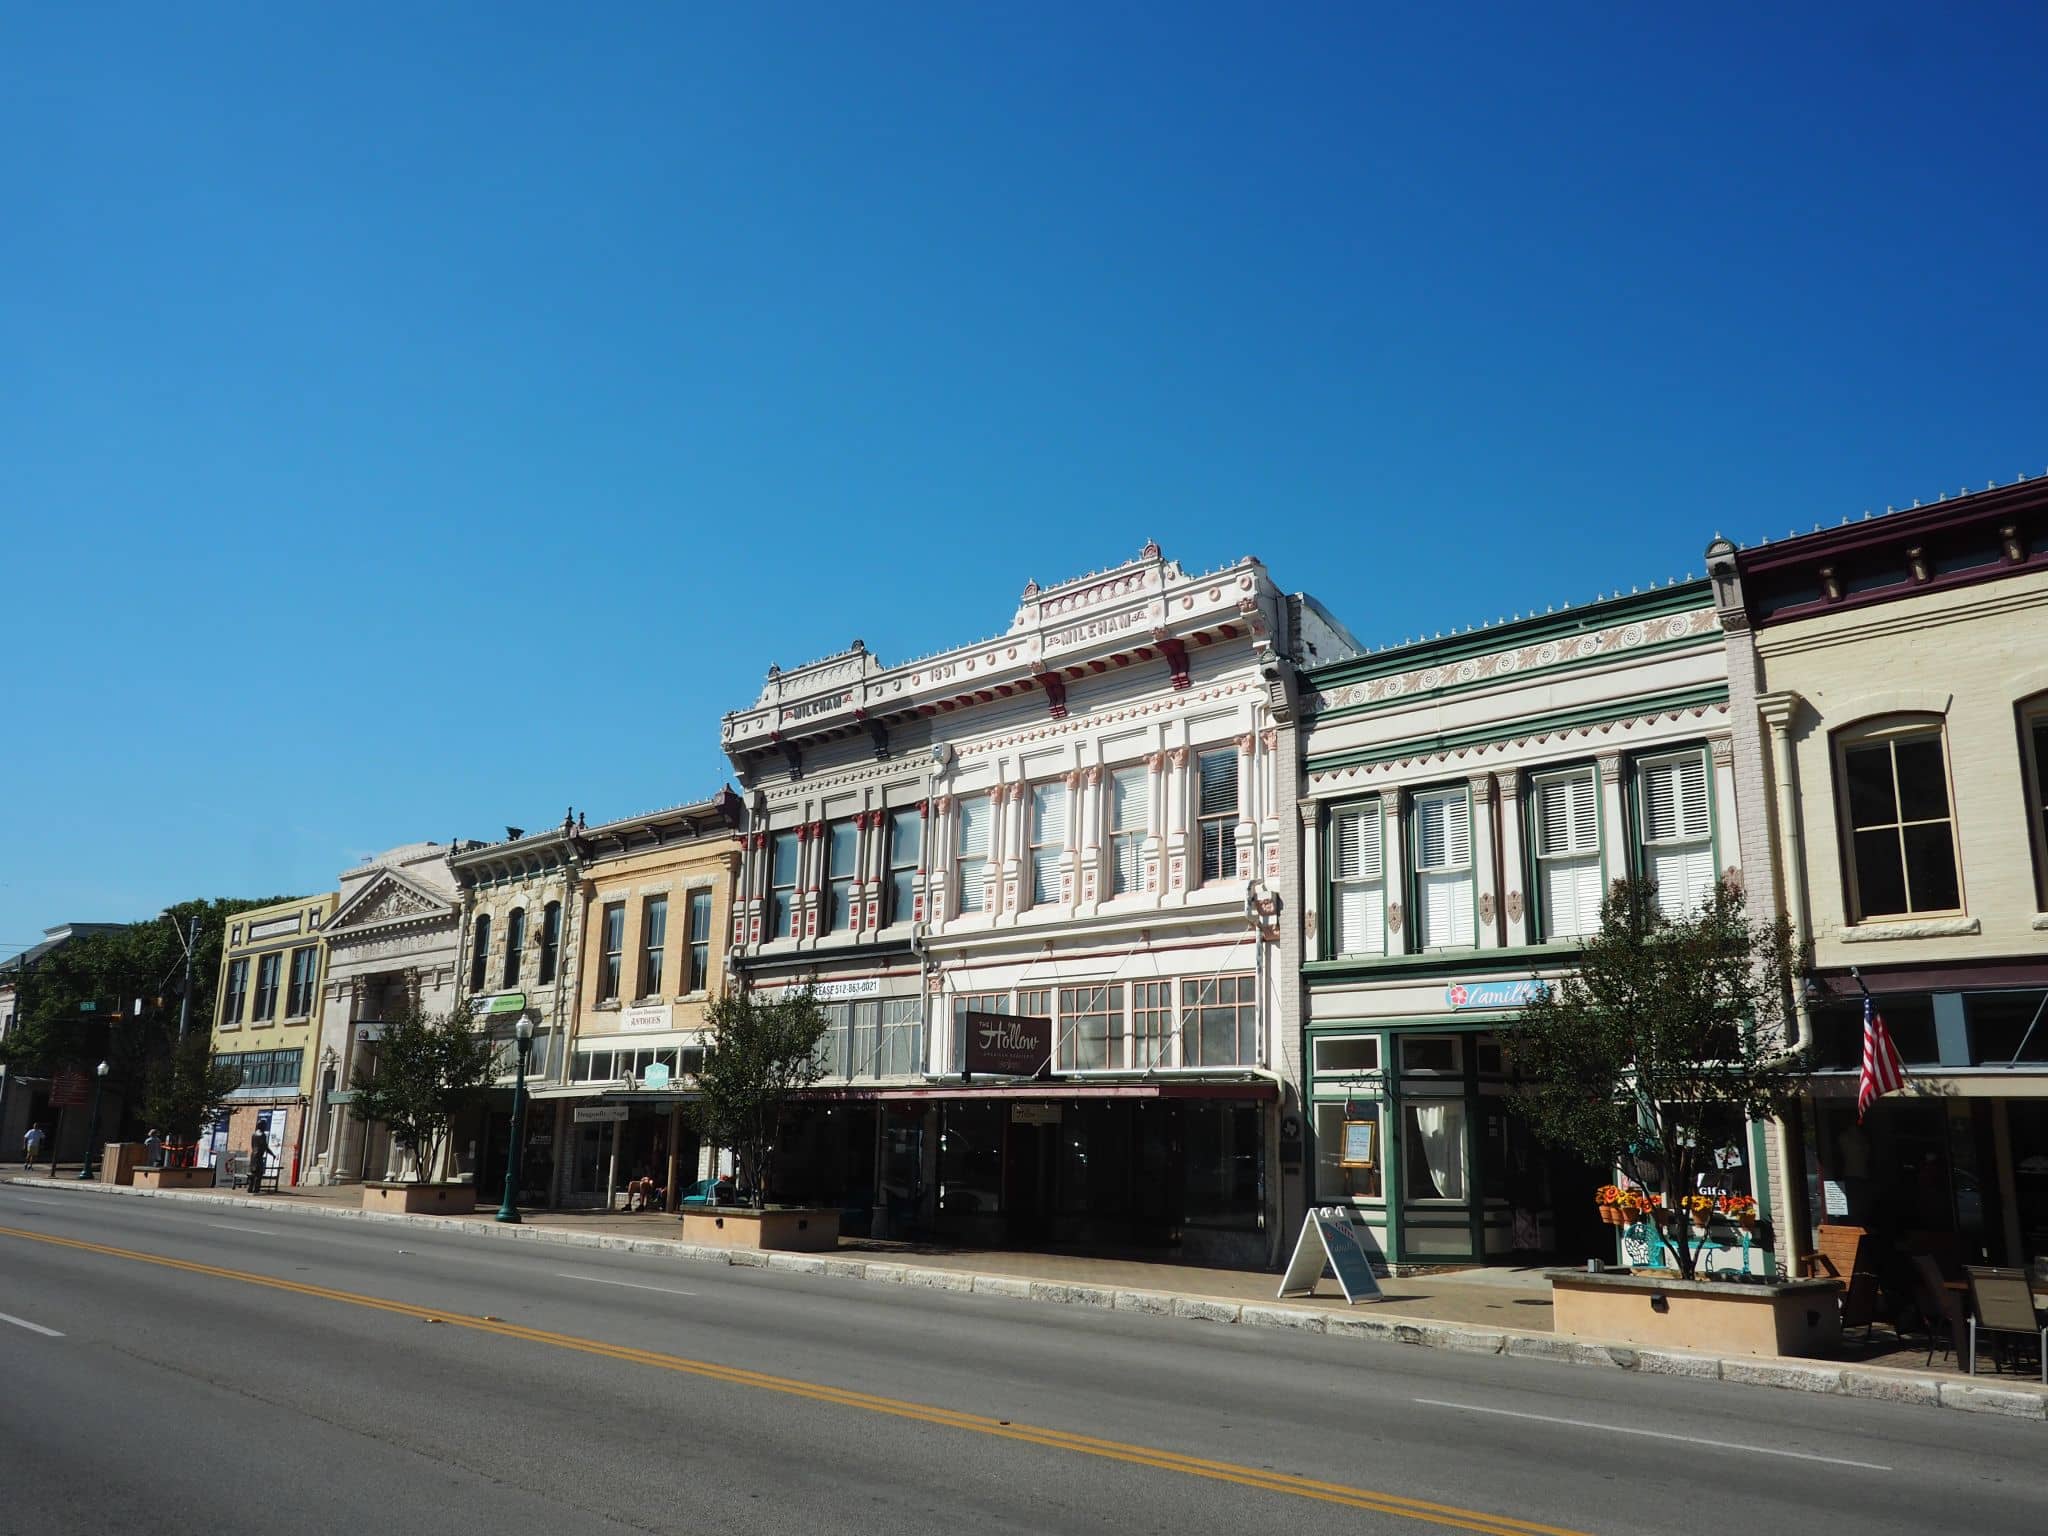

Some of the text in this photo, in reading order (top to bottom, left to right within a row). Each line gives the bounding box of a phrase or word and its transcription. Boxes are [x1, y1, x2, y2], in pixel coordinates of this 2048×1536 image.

[1060, 614, 1131, 646] MILEHAM
[929, 663, 957, 682] 1891
[793, 694, 842, 720] MILEHAM
[978, 1020, 1040, 1050] Hollow
